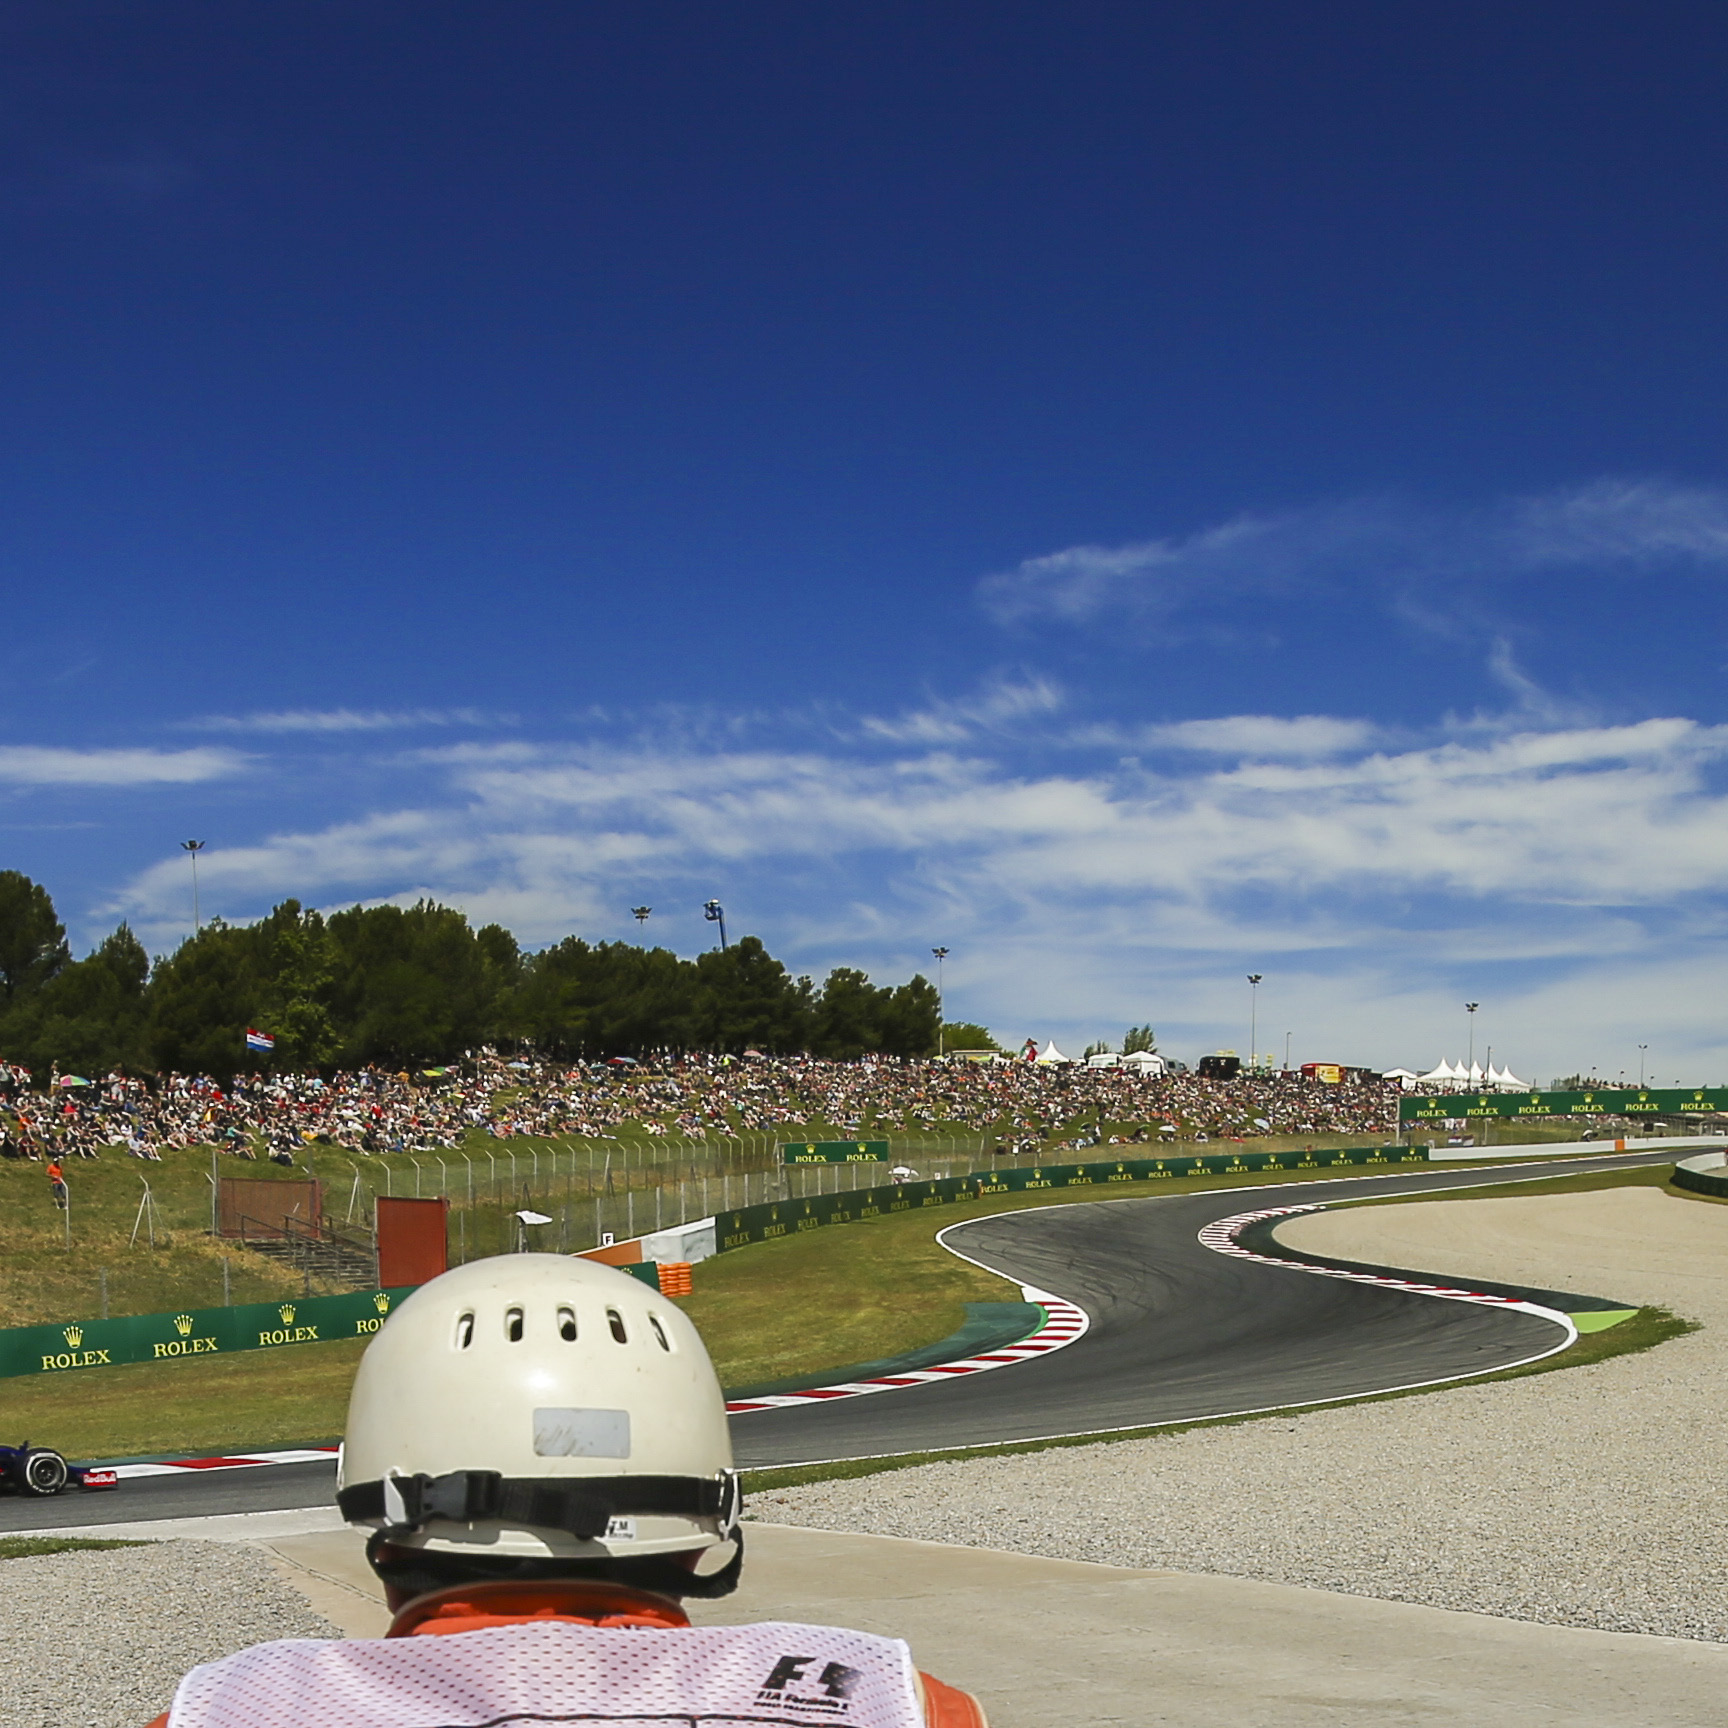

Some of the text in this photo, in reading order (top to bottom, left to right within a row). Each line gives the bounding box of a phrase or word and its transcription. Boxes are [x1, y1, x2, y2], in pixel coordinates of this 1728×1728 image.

[1519, 1106, 1550, 1114] ROLEX
[1625, 1103, 1658, 1111] ROLEX
[260, 1326, 320, 1347] ROLEX
[154, 1338, 218, 1359] ROLEX
[42, 1350, 111, 1369] ROLEX
